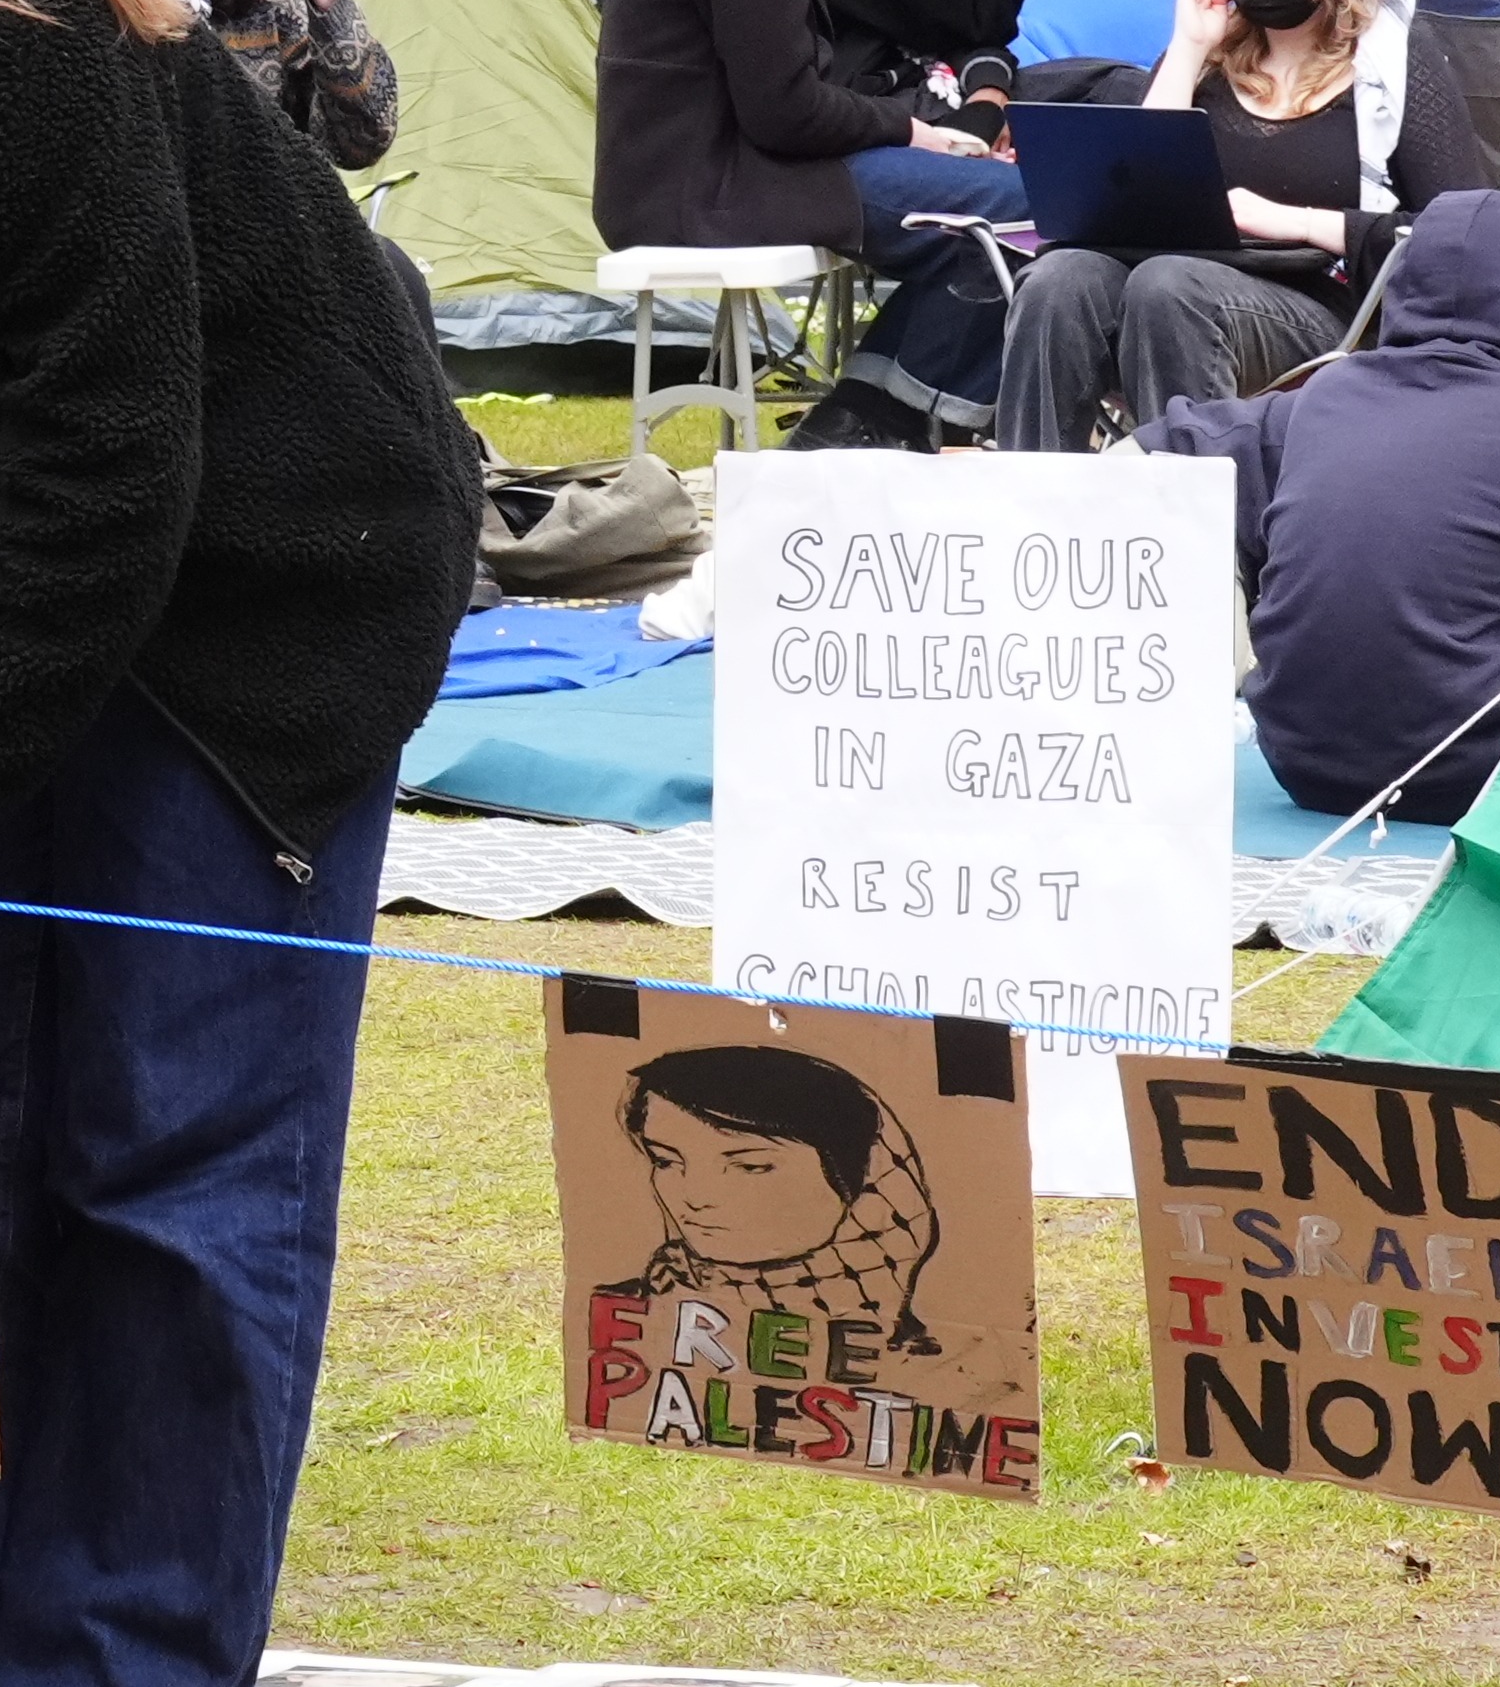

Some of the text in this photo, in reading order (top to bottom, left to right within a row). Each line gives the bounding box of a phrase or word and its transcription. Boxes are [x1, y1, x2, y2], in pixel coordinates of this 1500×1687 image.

[776, 527, 1168, 616] SAVE OUR
[772, 626, 1176, 704] COLLEAGUES
[813, 725, 1132, 804] IN GAZA
[801, 858, 1080, 921] RESIST
[588, 1291, 884, 1383] FREE
[585, 1348, 1040, 1491] PALESTINE
